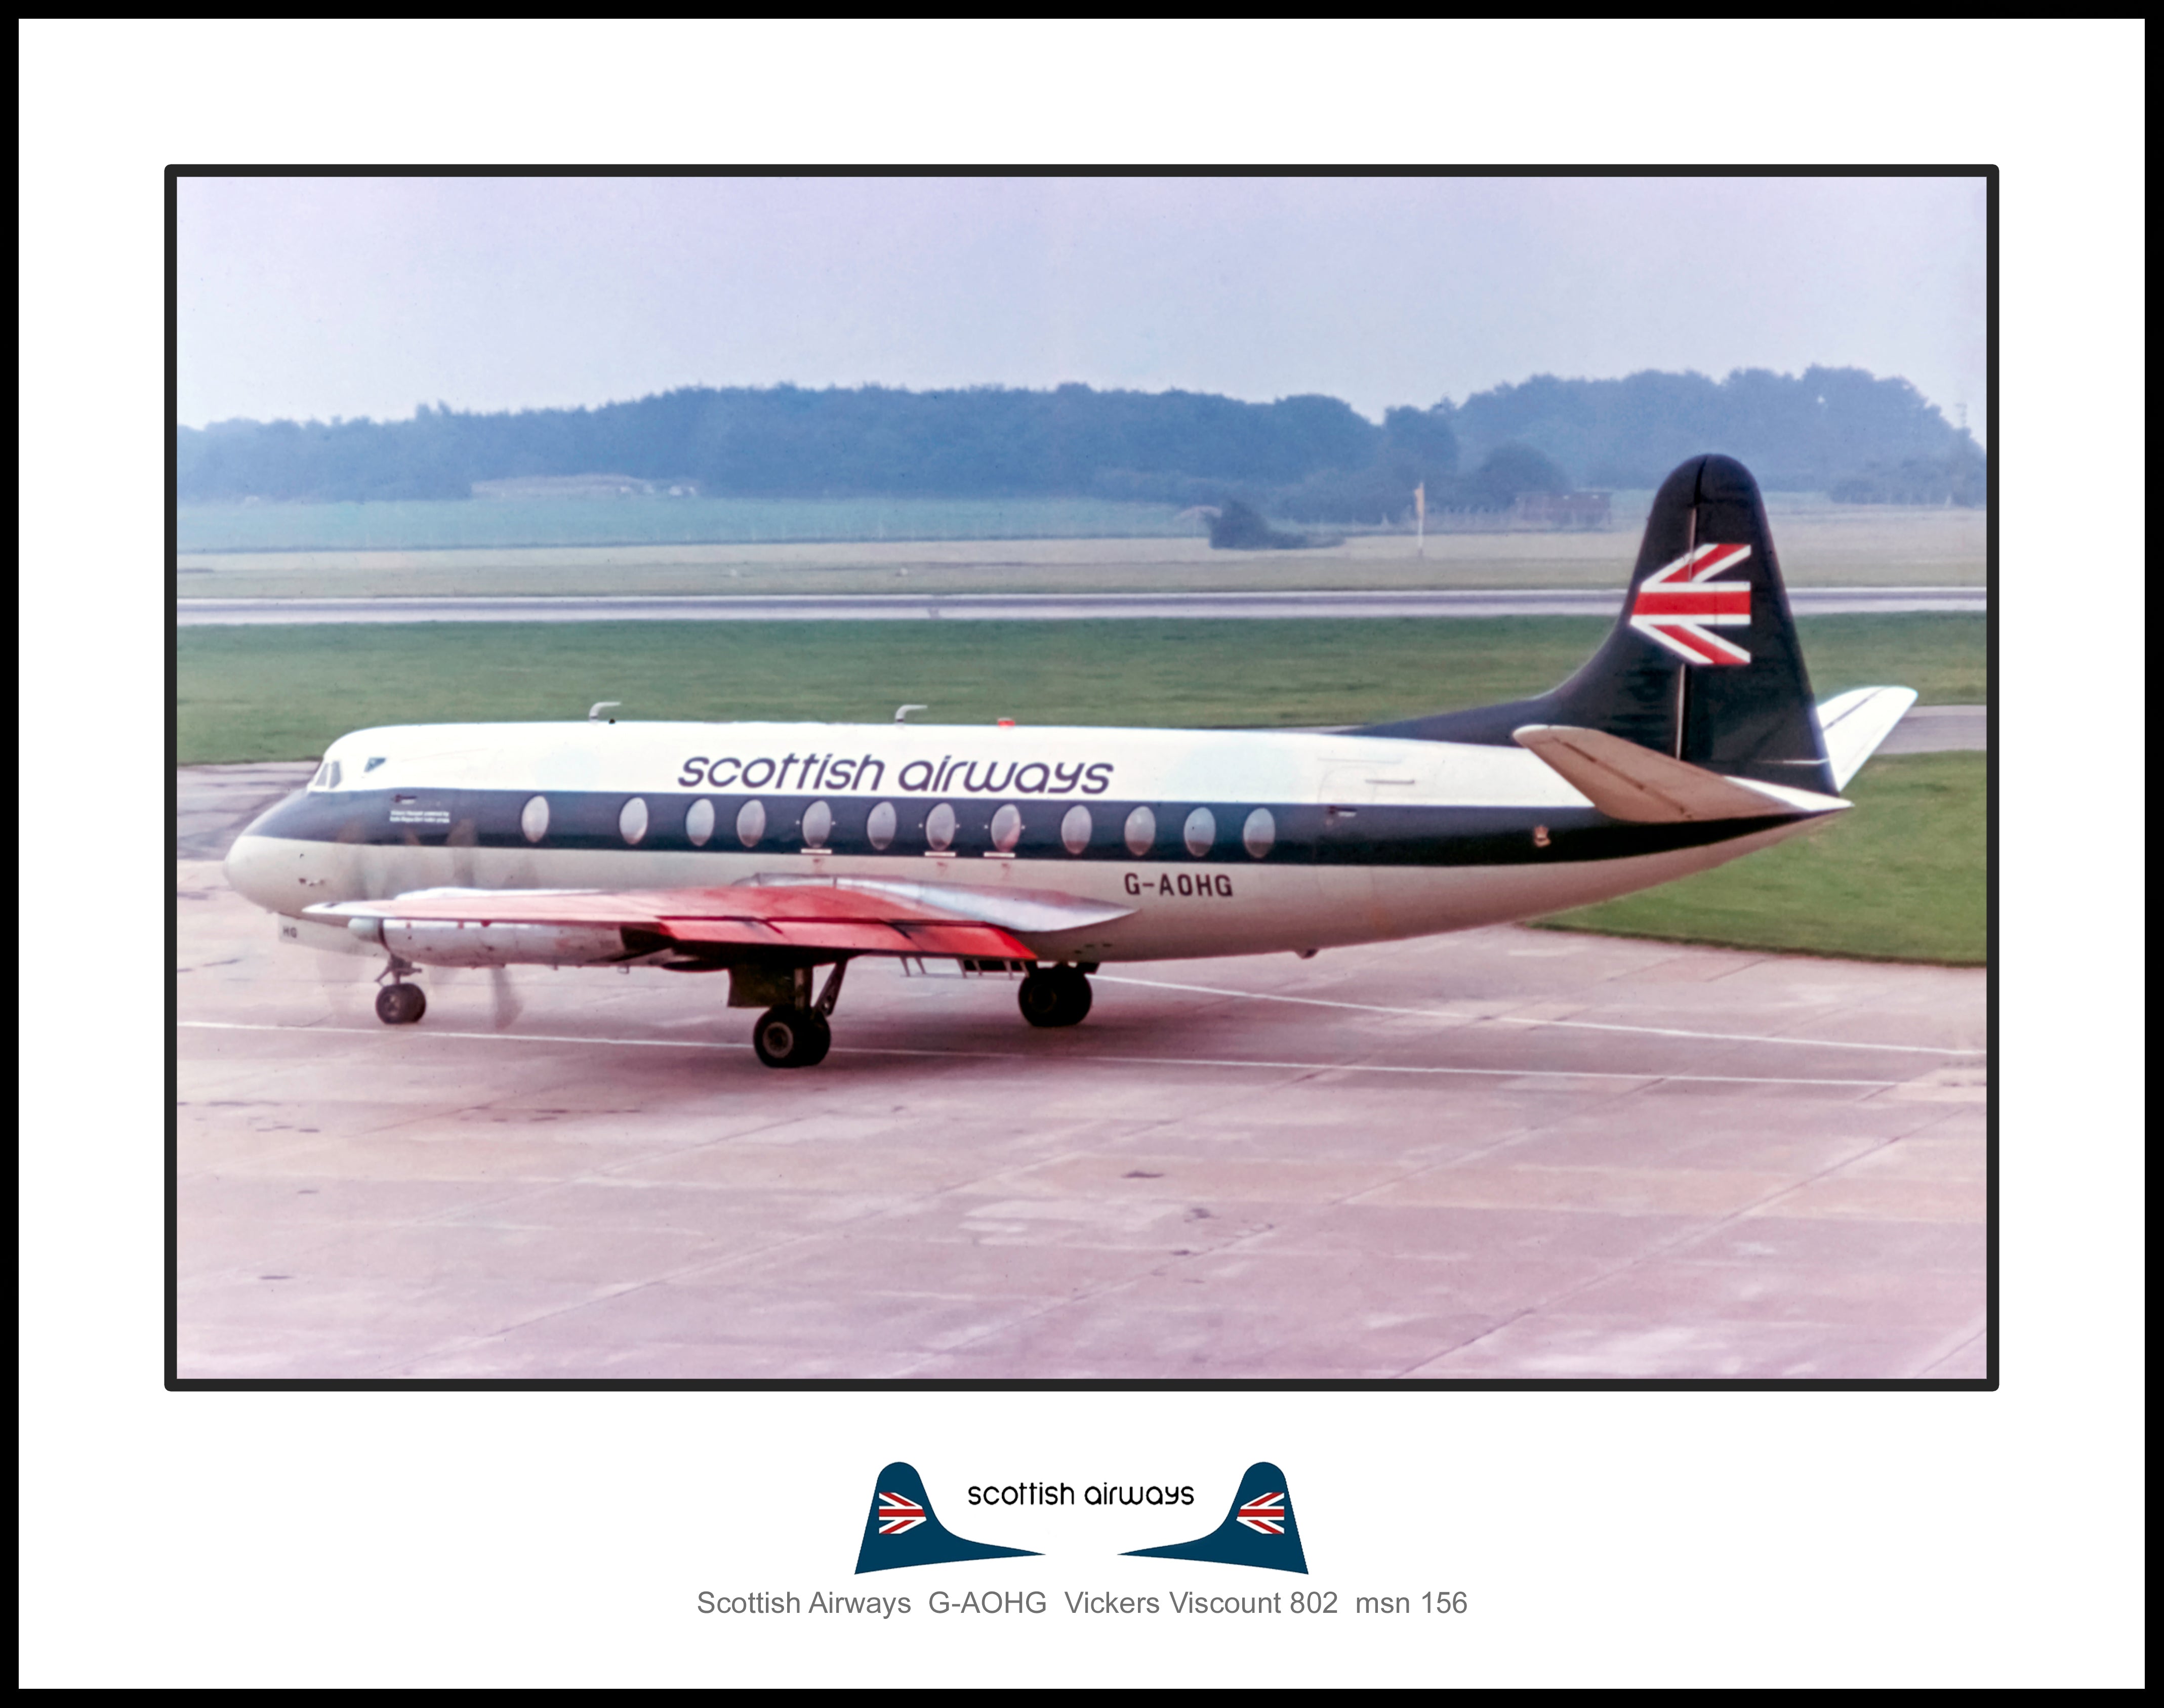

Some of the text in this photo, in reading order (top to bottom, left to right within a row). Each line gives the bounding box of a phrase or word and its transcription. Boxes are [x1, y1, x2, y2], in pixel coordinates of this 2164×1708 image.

[678, 753, 1114, 794] scottish airways
[1124, 872, 1234, 898] G-AOHG
[282, 926, 298, 939] HG
